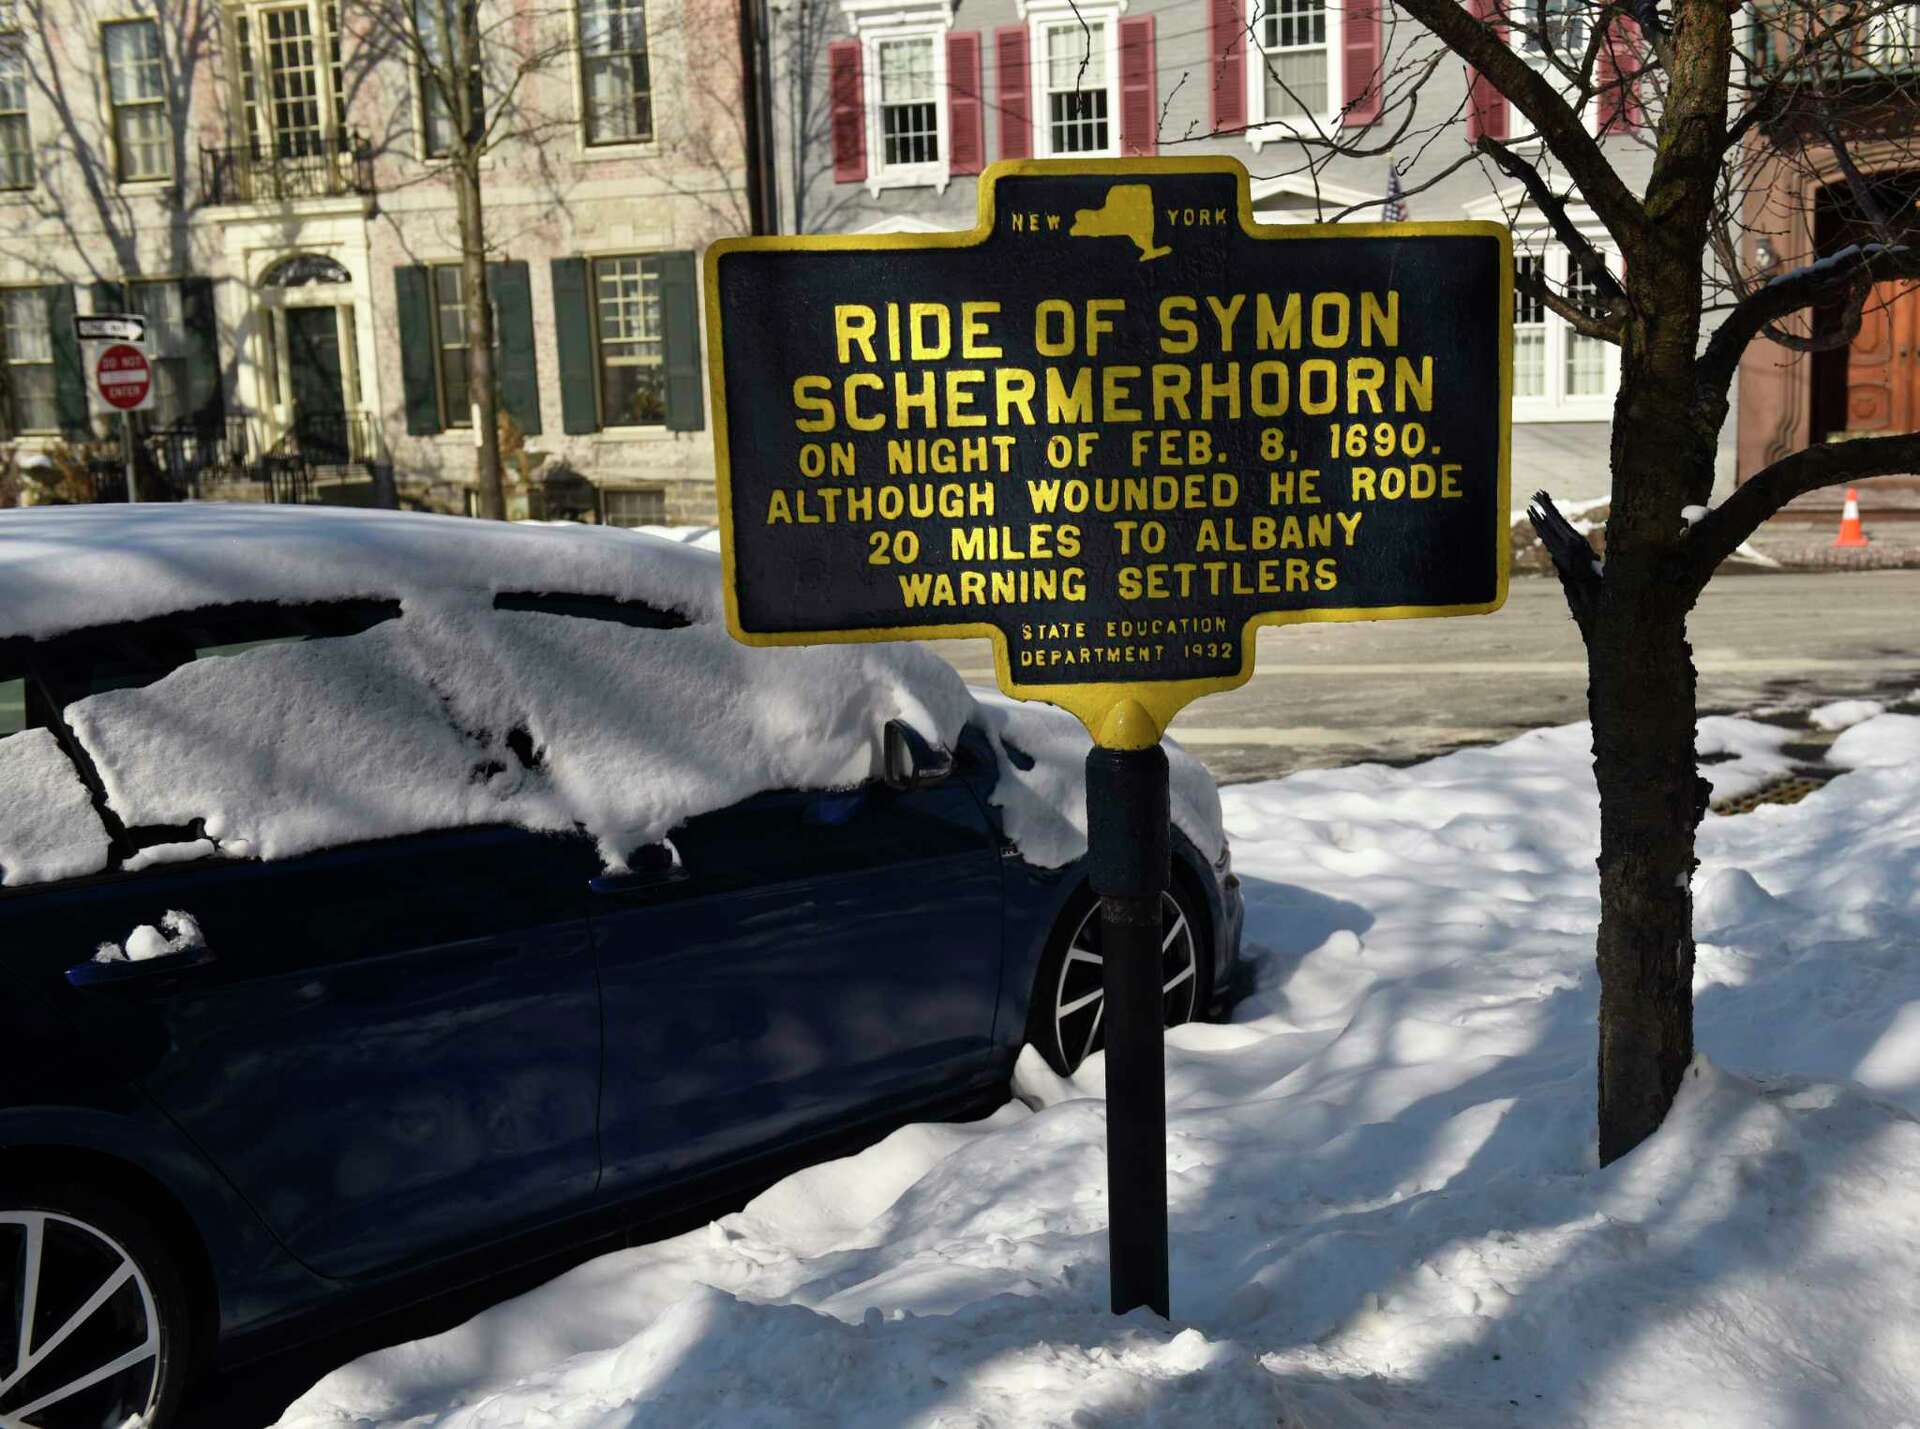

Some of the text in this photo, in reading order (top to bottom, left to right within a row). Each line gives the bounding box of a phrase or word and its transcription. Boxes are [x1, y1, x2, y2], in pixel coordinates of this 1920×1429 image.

[1011, 207, 1227, 232] NEW YORK
[834, 290, 1399, 363] RIDE OF SYMON
[793, 355, 1434, 433] SCHERMERHOORN
[799, 422, 1441, 478] ON NIGHT OF FEB. 8, 1690.
[767, 463, 1464, 524] ALTHOUGH WOUNDED HE RODE
[868, 511, 1363, 565] 20 MILES TO ALBANY
[898, 557, 1338, 608] WARNING SETTLERS
[1020, 642, 1233, 667] DEPARTMENT 1932
[1021, 616, 1226, 641] STATE EDUCATION
